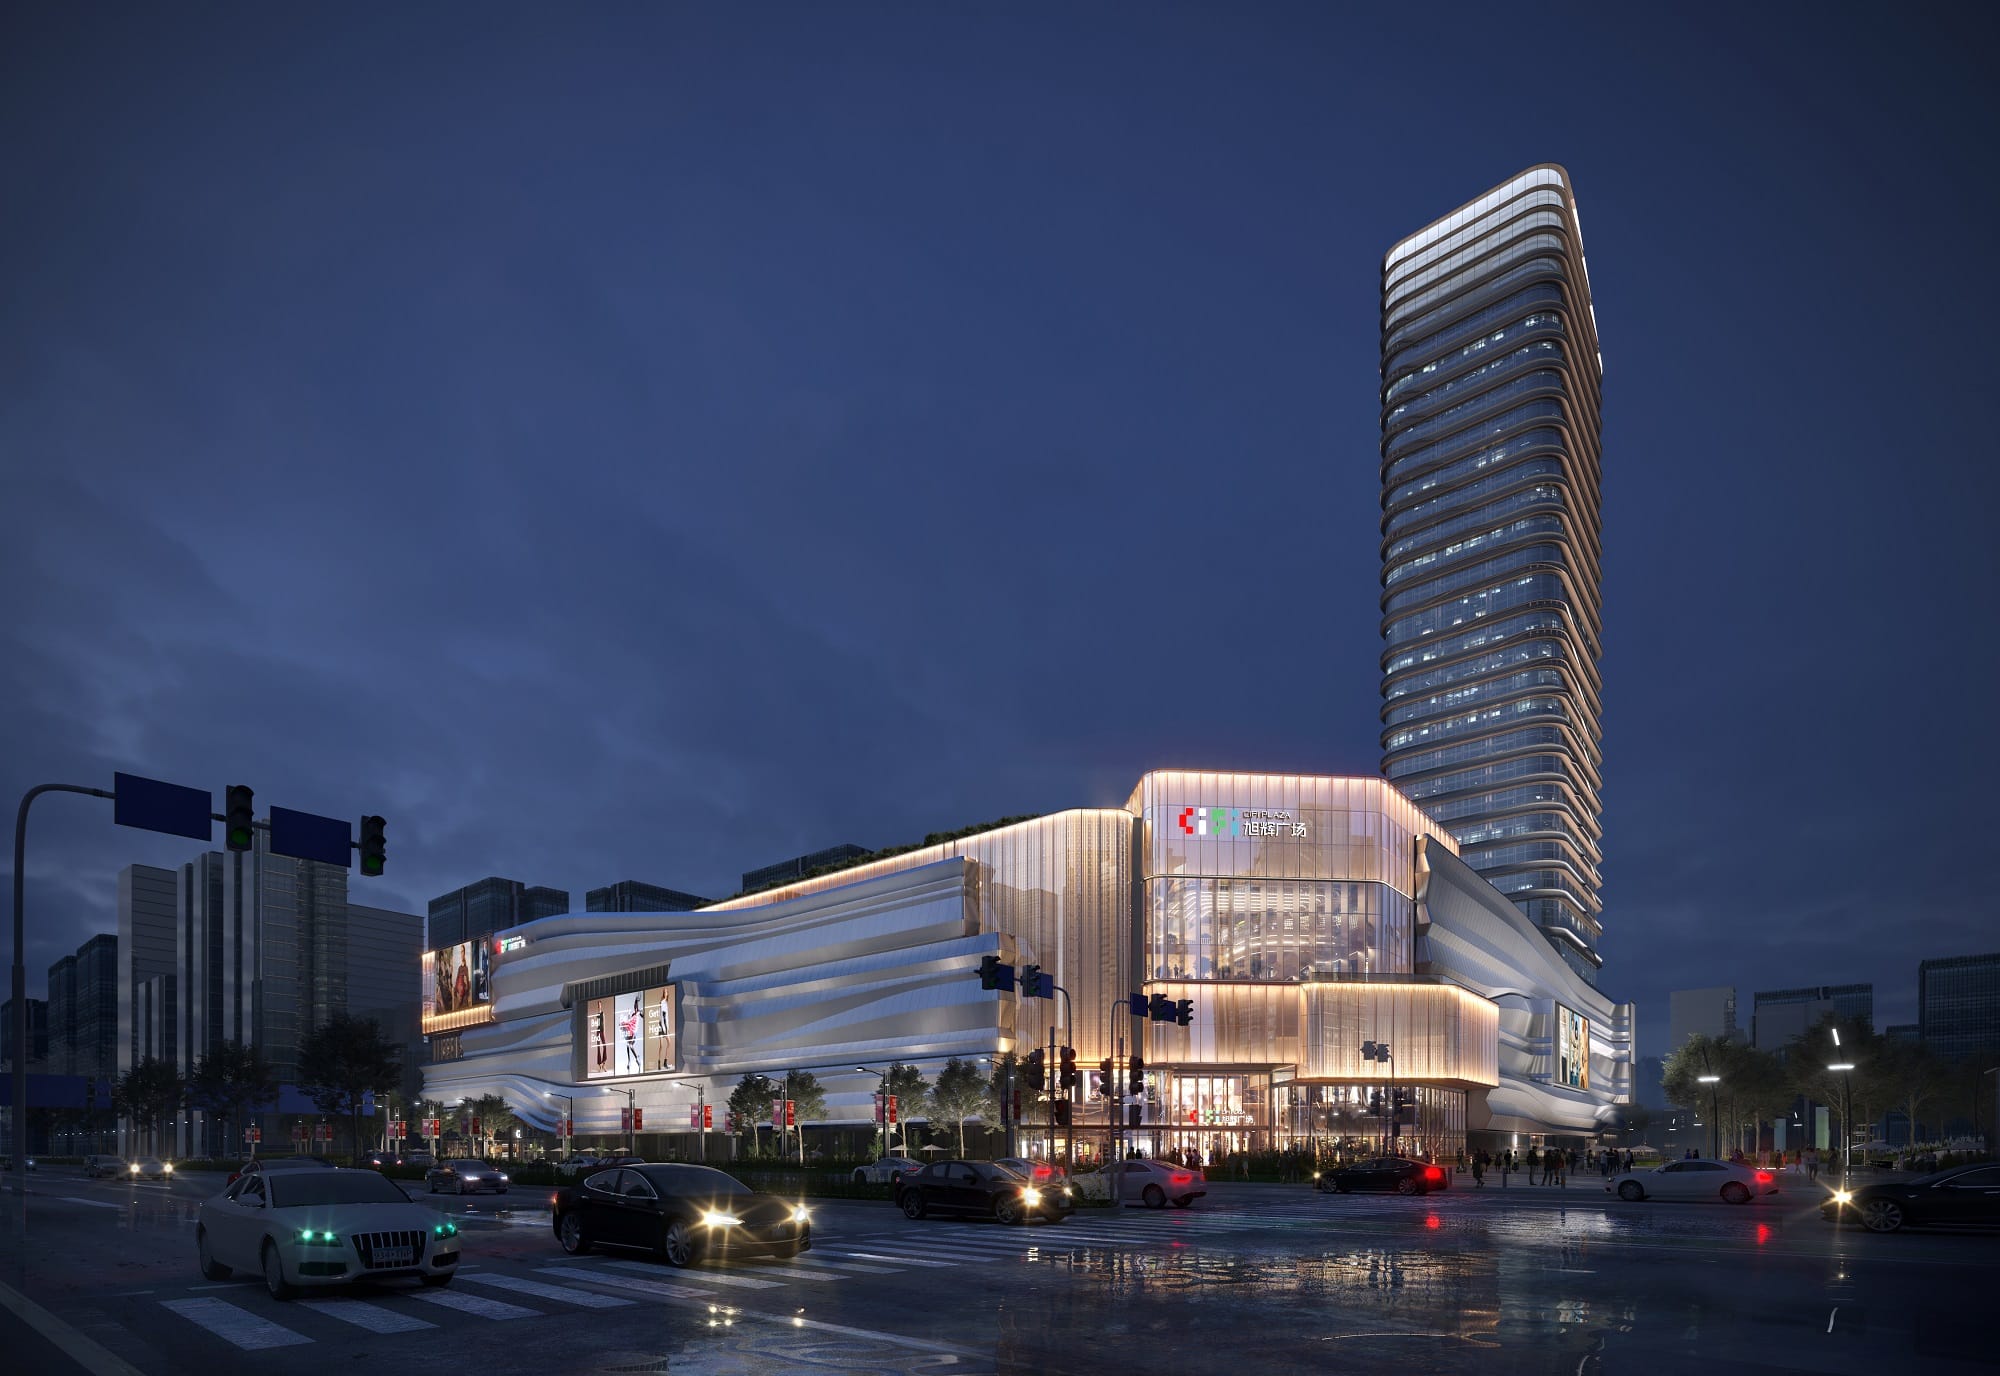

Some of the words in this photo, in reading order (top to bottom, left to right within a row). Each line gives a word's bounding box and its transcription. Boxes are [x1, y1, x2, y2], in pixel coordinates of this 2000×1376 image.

[1262, 811, 1291, 819] PLAZA
[1244, 821, 1306, 837] 旭辉广场
